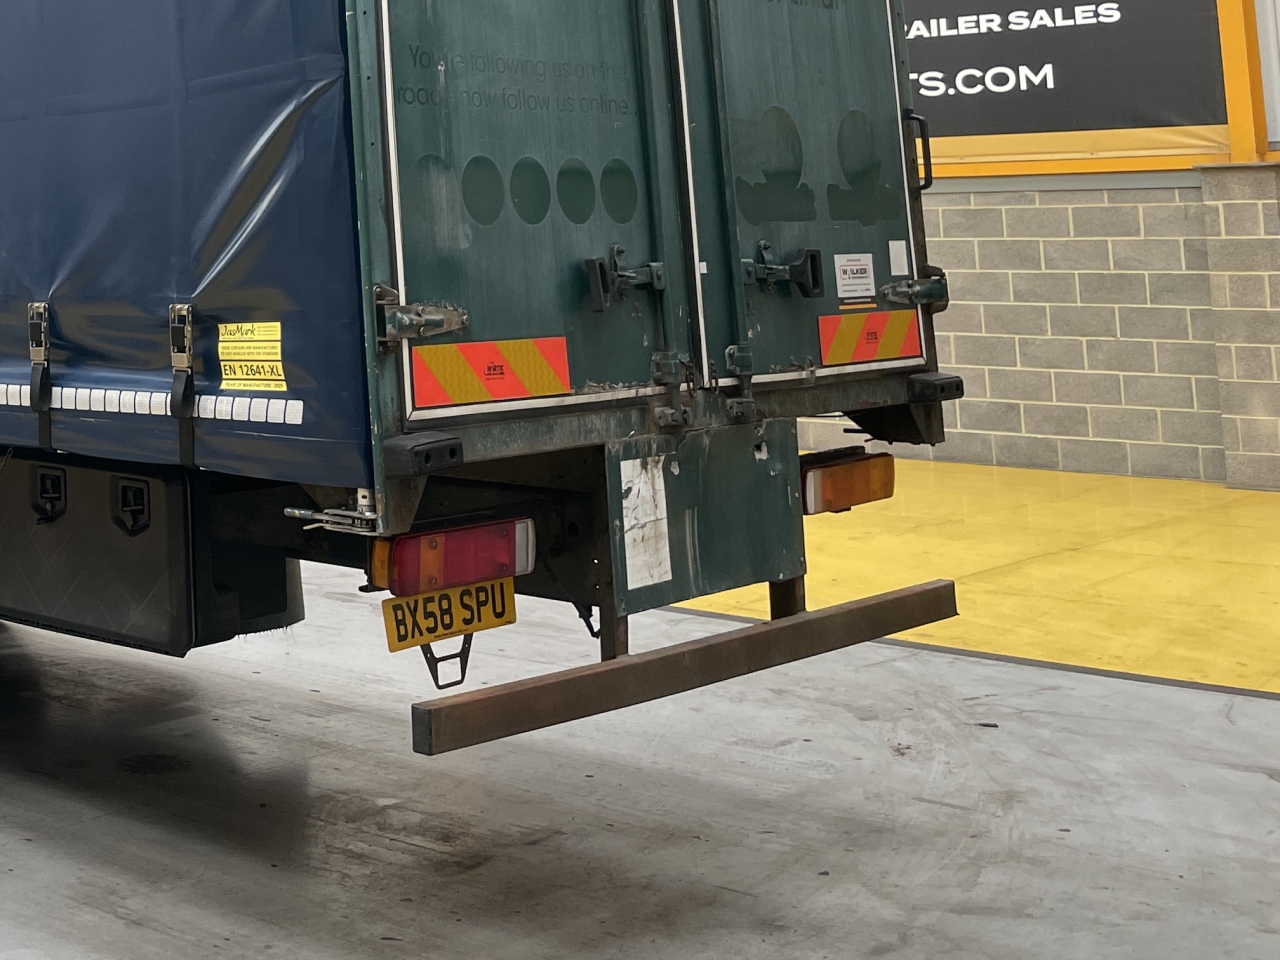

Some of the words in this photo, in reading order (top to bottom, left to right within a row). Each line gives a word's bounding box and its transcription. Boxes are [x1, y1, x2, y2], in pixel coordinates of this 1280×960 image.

[905, 13, 1002, 39] AILER
[1007, 2, 1121, 31] SALES
[471, 51, 546, 83] following
[552, 60, 570, 79] us
[502, 87, 550, 112] follow
[556, 96, 574, 114] us
[221, 324, 256, 337] JasMark
[223, 364, 236, 376] EN
[239, 365, 282, 377] 12641-XL
[392, 594, 454, 643] BX58
[460, 582, 506, 625] SPU
